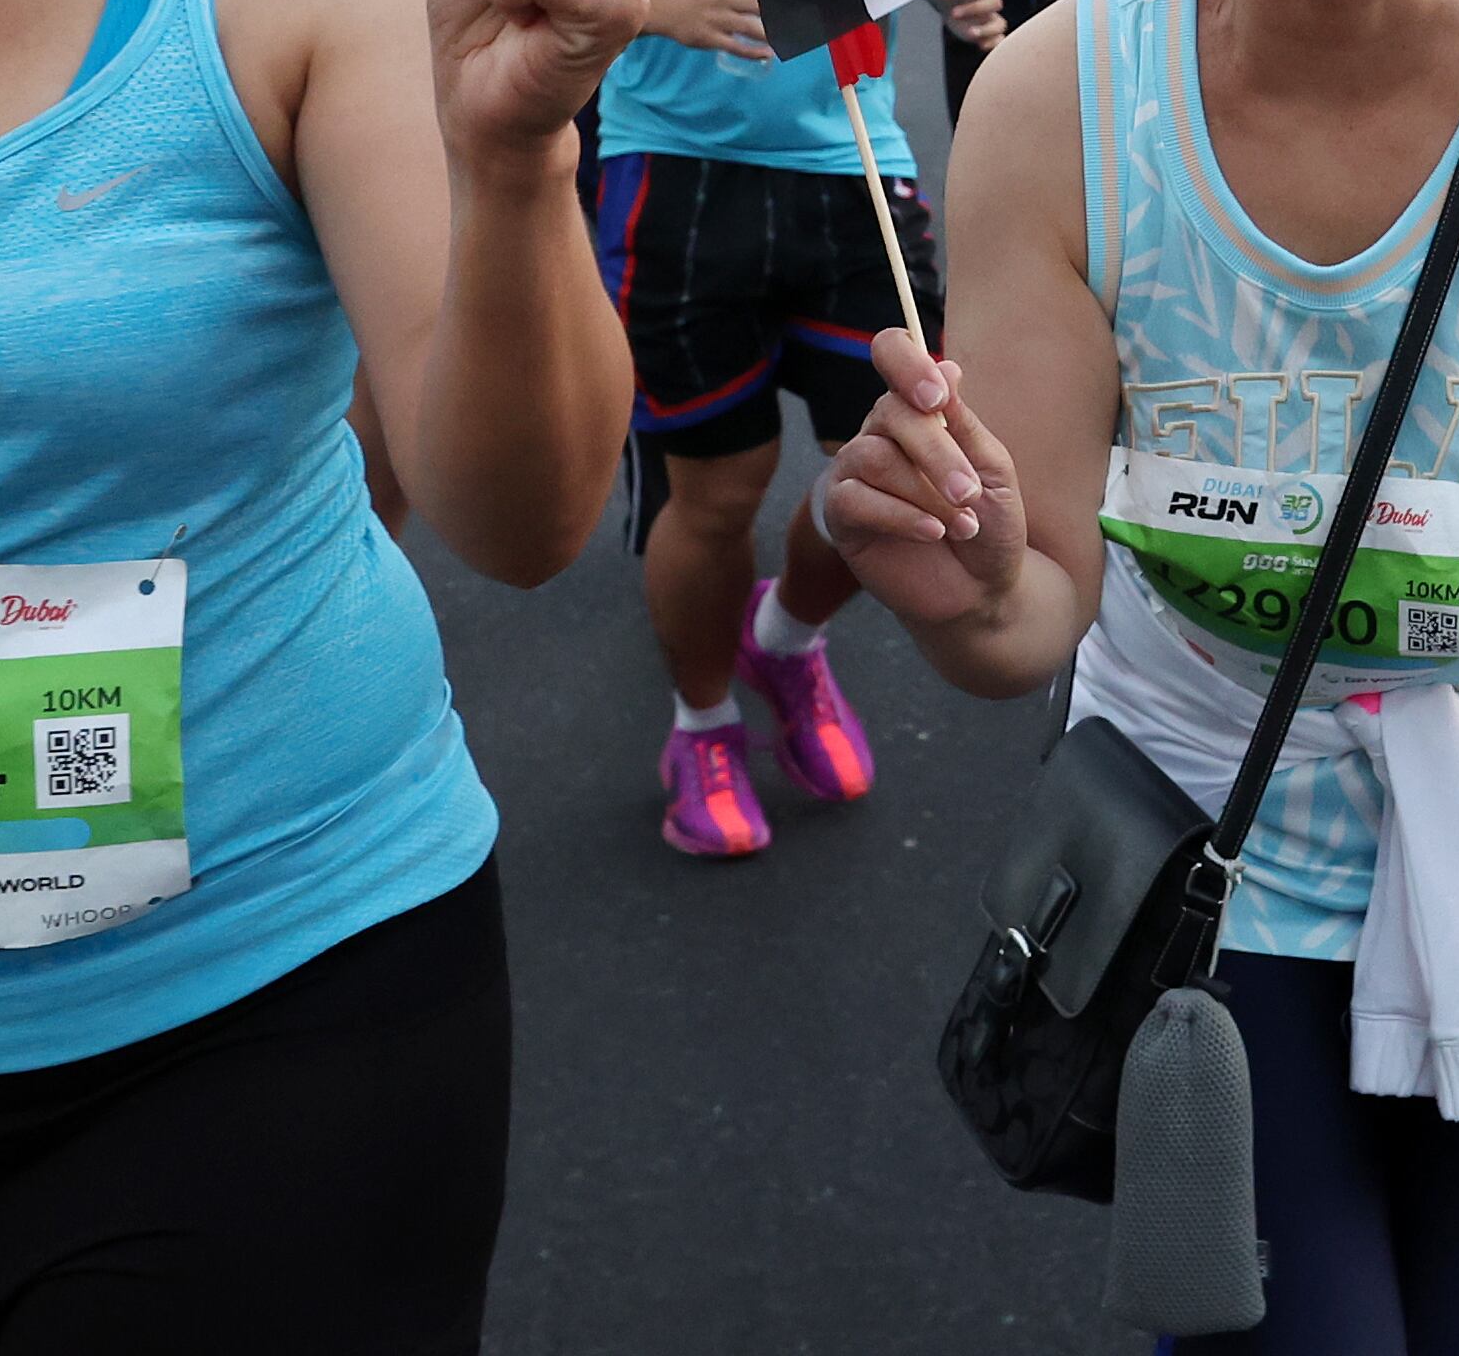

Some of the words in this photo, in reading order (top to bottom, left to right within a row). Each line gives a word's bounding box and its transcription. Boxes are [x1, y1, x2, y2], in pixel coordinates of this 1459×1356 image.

[1203, 478, 1263, 499] DUBAI
[1169, 491, 1258, 525] RUN
[1376, 502, 1431, 527] Dubai
[0, 595, 72, 625] Dubai
[43, 687, 122, 712] 10KM
